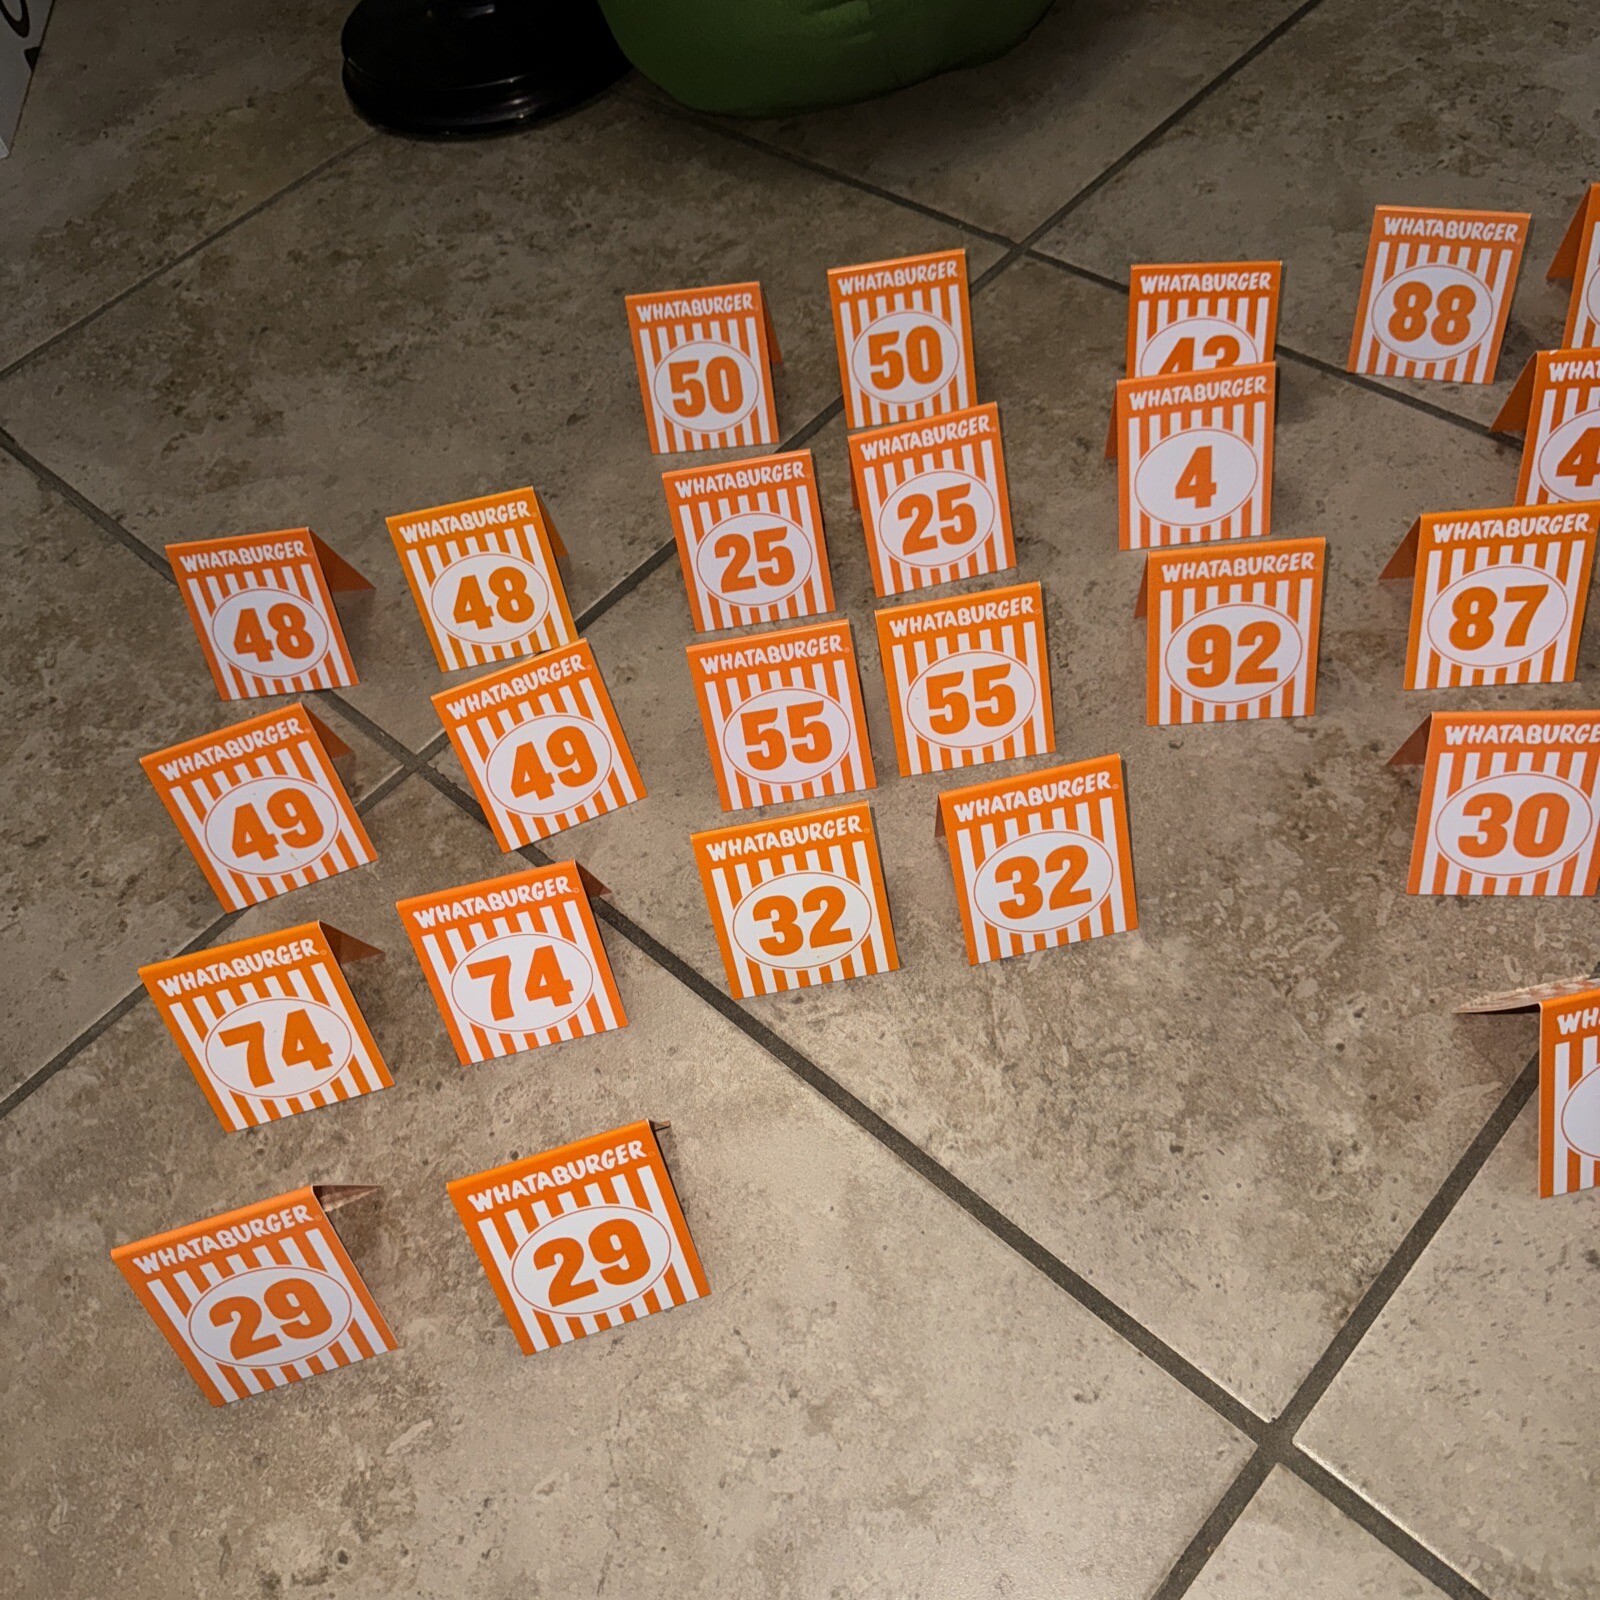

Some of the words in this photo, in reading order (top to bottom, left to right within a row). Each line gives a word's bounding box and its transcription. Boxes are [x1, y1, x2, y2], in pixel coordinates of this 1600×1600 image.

[1384, 217, 1518, 242] WHATABURGER
[636, 293, 752, 322] WHATABURGER
[838, 261, 957, 295] WHATABURGER
[1140, 272, 1271, 294] WHATABURGER
[1389, 282, 1476, 345] 88
[668, 356, 744, 418] 50
[868, 325, 942, 391] 50
[1129, 376, 1266, 410] WHATABURGER
[860, 415, 990, 461] WHATABURGER
[675, 462, 804, 498] WHATABURGER
[1175, 446, 1217, 508] 4
[400, 501, 530, 543] WHATABURGER
[897, 483, 978, 556] 25
[1434, 513, 1589, 543] WHATABURGER
[180, 541, 306, 572] WHATABURGER
[714, 526, 795, 593] 25
[1162, 552, 1314, 582] WHATABURGER
[452, 566, 535, 630] 48
[890, 597, 1033, 637] WHATABURGER
[1449, 584, 1549, 651] 87
[233, 602, 315, 663] 48
[700, 635, 842, 674] WHATABURGER
[1186, 621, 1281, 689] 92
[446, 655, 585, 719] WHATABURGER
[925, 663, 1017, 735] 55
[158, 718, 303, 781] WHATABURGER
[510, 725, 598, 801] 49
[740, 700, 833, 771] 55
[231, 788, 324, 861] 49
[954, 772, 1111, 822] WHATABURGER
[1458, 792, 1570, 858] 30
[706, 816, 861, 861] WHATABURGER
[413, 877, 572, 928] WHATABURGER
[994, 845, 1092, 920] 32
[752, 885, 853, 957] 32
[158, 939, 318, 996] WHATABURGER
[466, 945, 573, 1022] 74
[218, 1009, 333, 1088] 74
[468, 1141, 646, 1212] WHATABURGER
[133, 1205, 312, 1274] WHATABURGER
[533, 1218, 651, 1307] 29
[209, 1278, 332, 1360] 29
